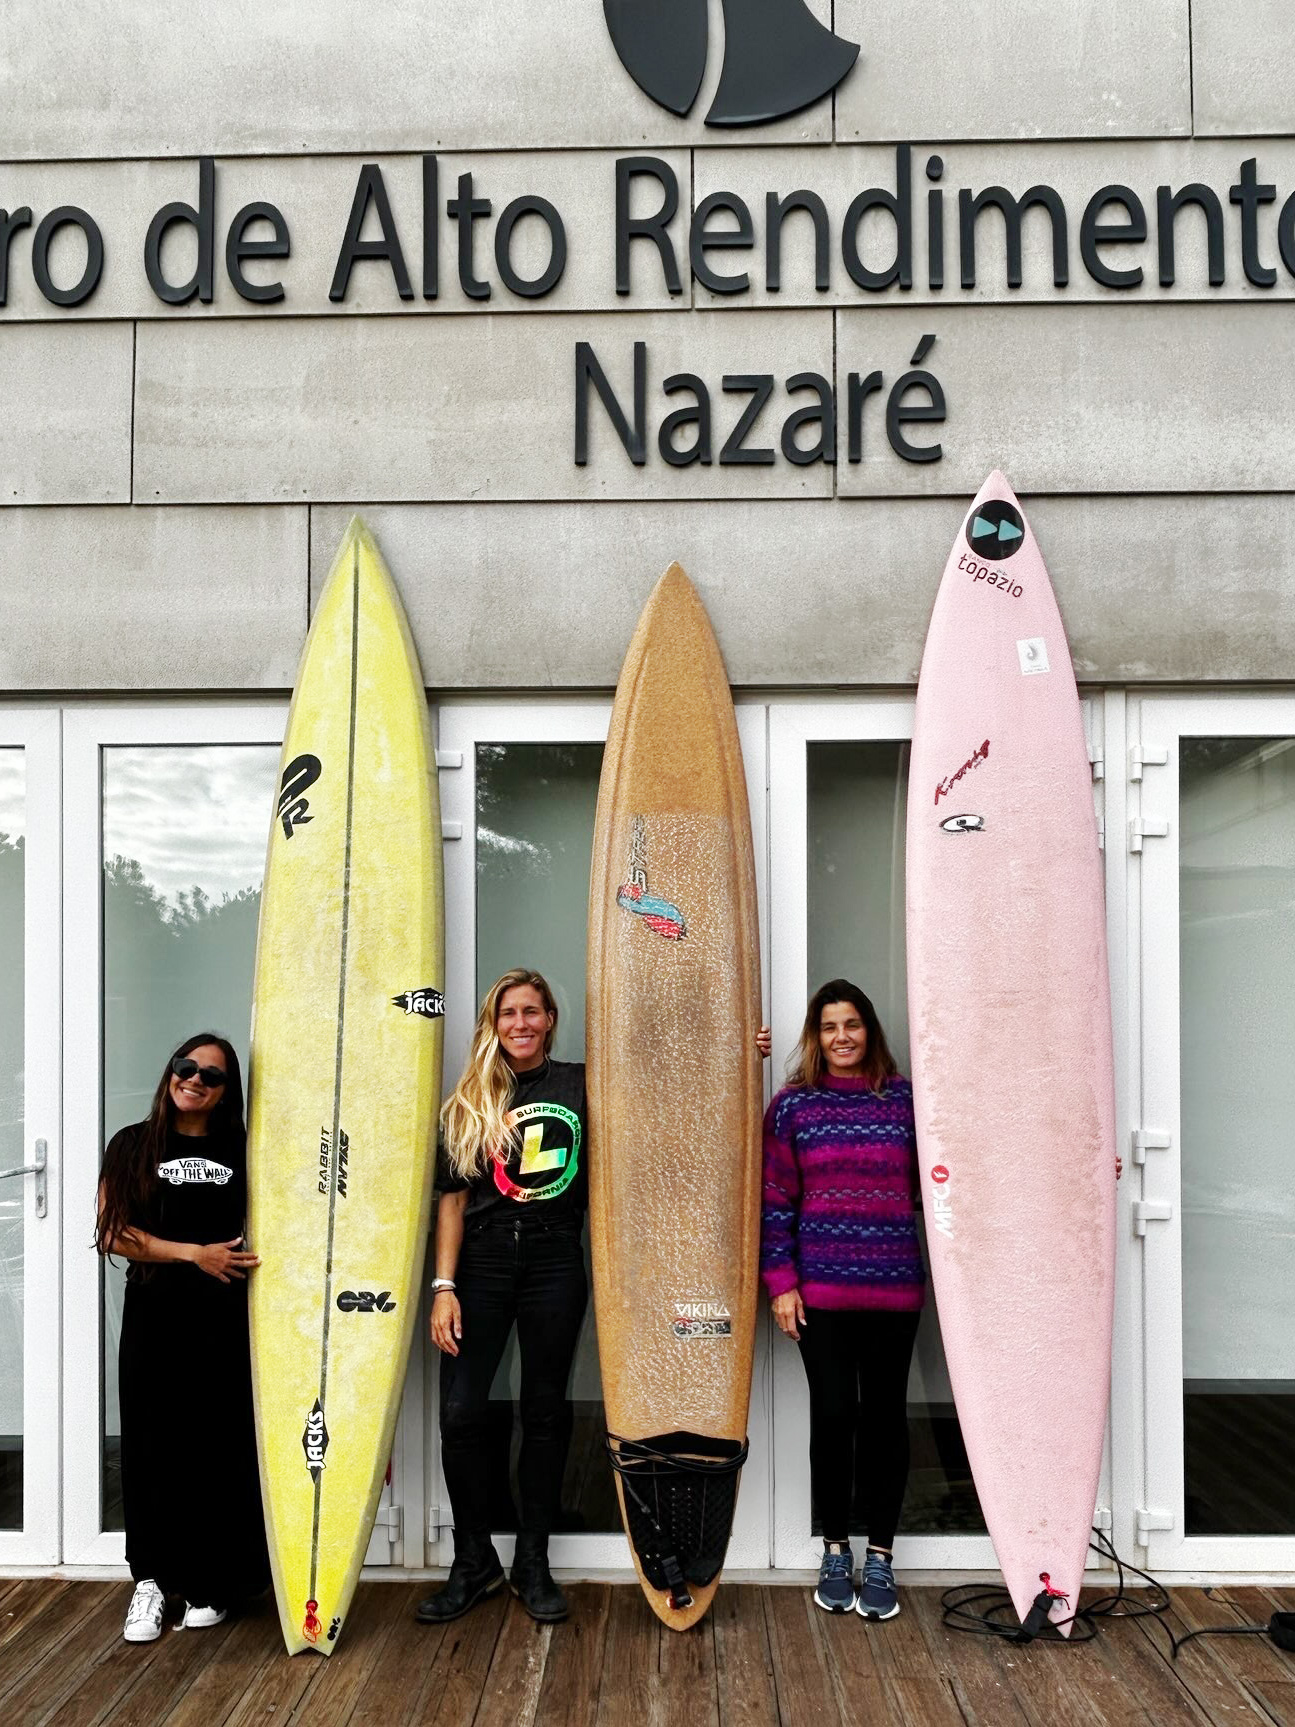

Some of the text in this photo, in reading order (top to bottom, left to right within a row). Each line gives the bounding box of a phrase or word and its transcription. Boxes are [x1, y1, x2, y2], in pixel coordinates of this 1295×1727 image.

[144, 157, 290, 304] de
[329, 154, 567, 301] Alto
[615, 143, 1295, 295] Rendiment
[574, 334, 947, 467] Nazaré
[957, 553, 1024, 598] topazio
[182, 1168, 202, 1180] THE
[318, 1126, 331, 1195] RABBIT
[932, 1183, 955, 1240] MFC
